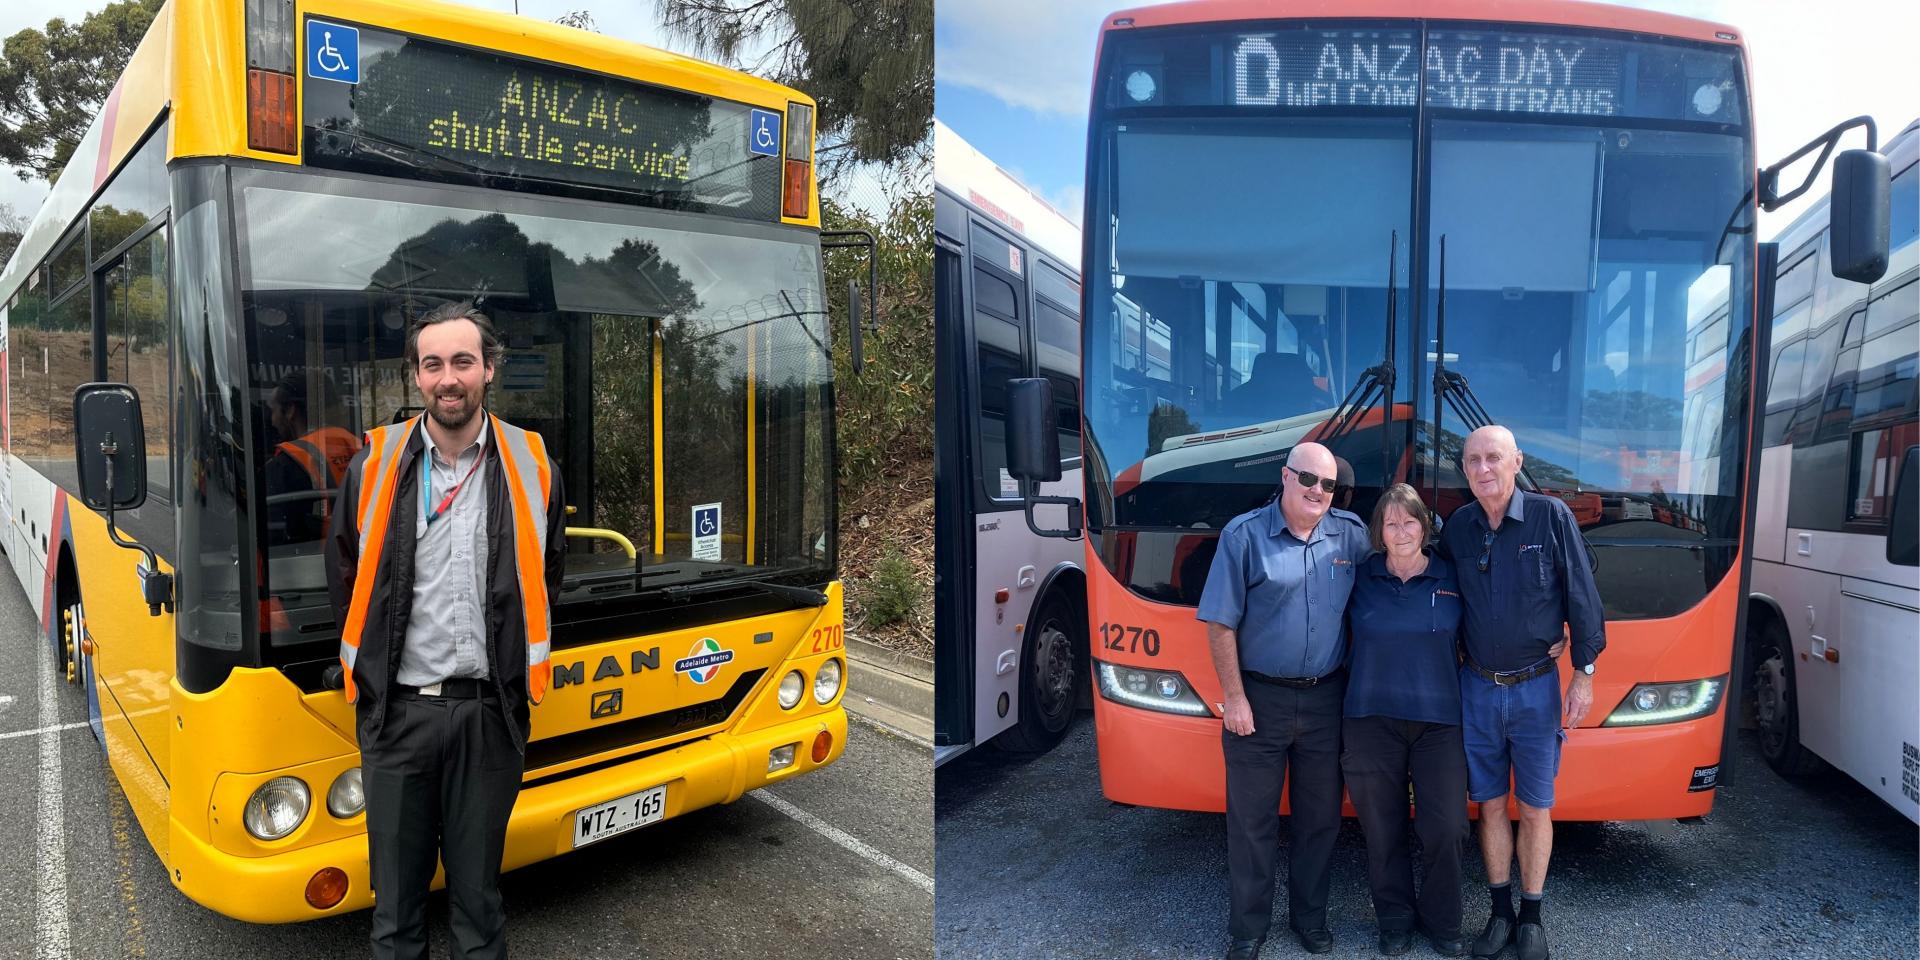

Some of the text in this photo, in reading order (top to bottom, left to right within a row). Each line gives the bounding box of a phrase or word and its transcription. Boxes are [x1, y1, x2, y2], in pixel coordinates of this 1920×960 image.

[1500, 47, 1581, 85] DAY
[501, 69, 639, 134] ANZAC
[1450, 85, 1614, 116] VETERANS
[428, 110, 691, 180] shuttle service
[1099, 621, 1160, 657] 1270
[553, 646, 660, 690] MAN
[680, 652, 730, 670] Adelaide Metro
[581, 805, 618, 838] WTZ
[634, 791, 662, 820] 165
[592, 818, 647, 841] SOUTH AUSTRALIA
